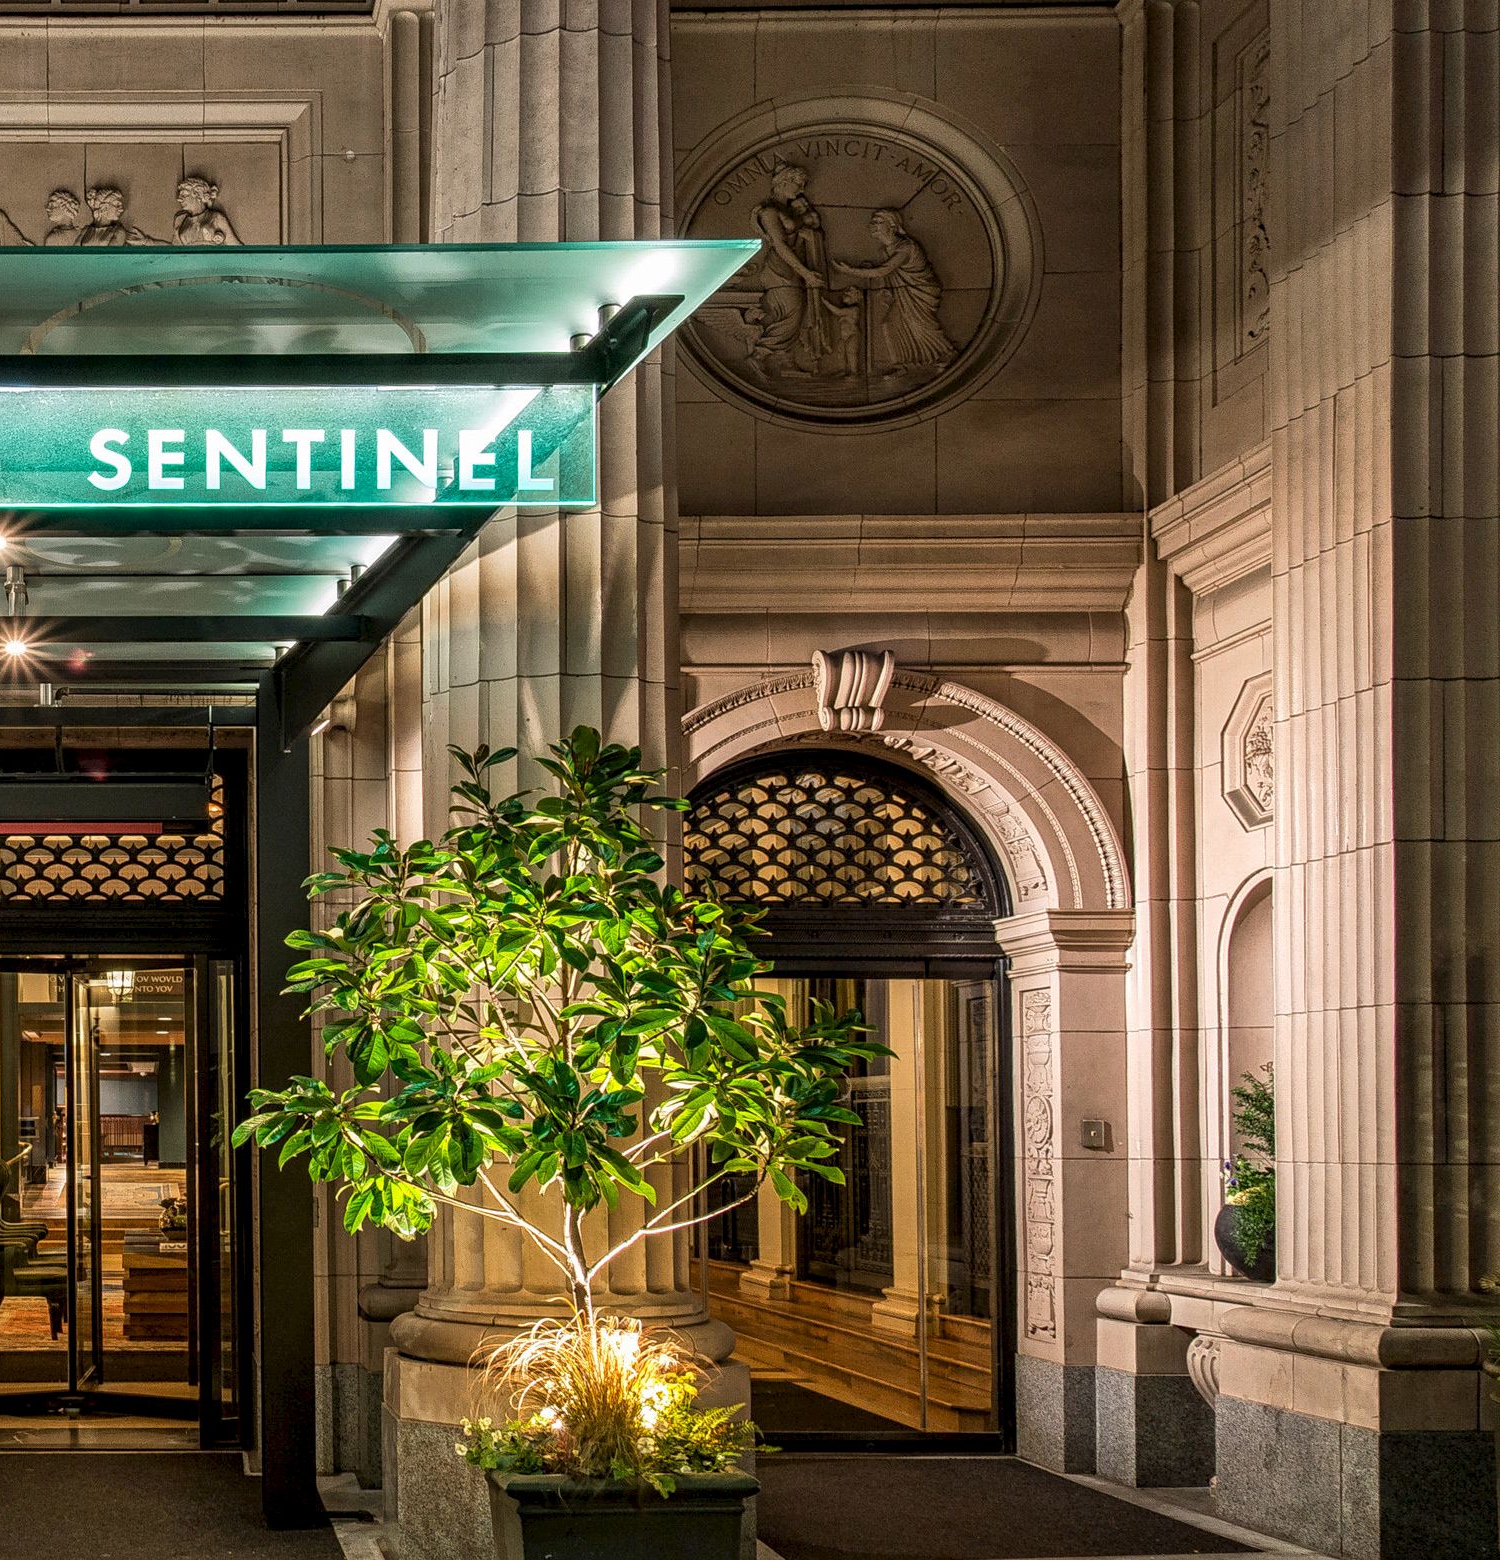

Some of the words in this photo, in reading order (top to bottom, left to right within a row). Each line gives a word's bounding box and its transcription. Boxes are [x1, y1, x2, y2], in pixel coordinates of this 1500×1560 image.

[713, 151, 787, 206] OMNIA
[796, 139, 888, 161] VINCIT
[896, 157, 962, 211] AMOR
[86, 427, 555, 491] SENTINEL
[151, 975, 183, 983] WOVLD
[155, 985, 173, 993] YOV
